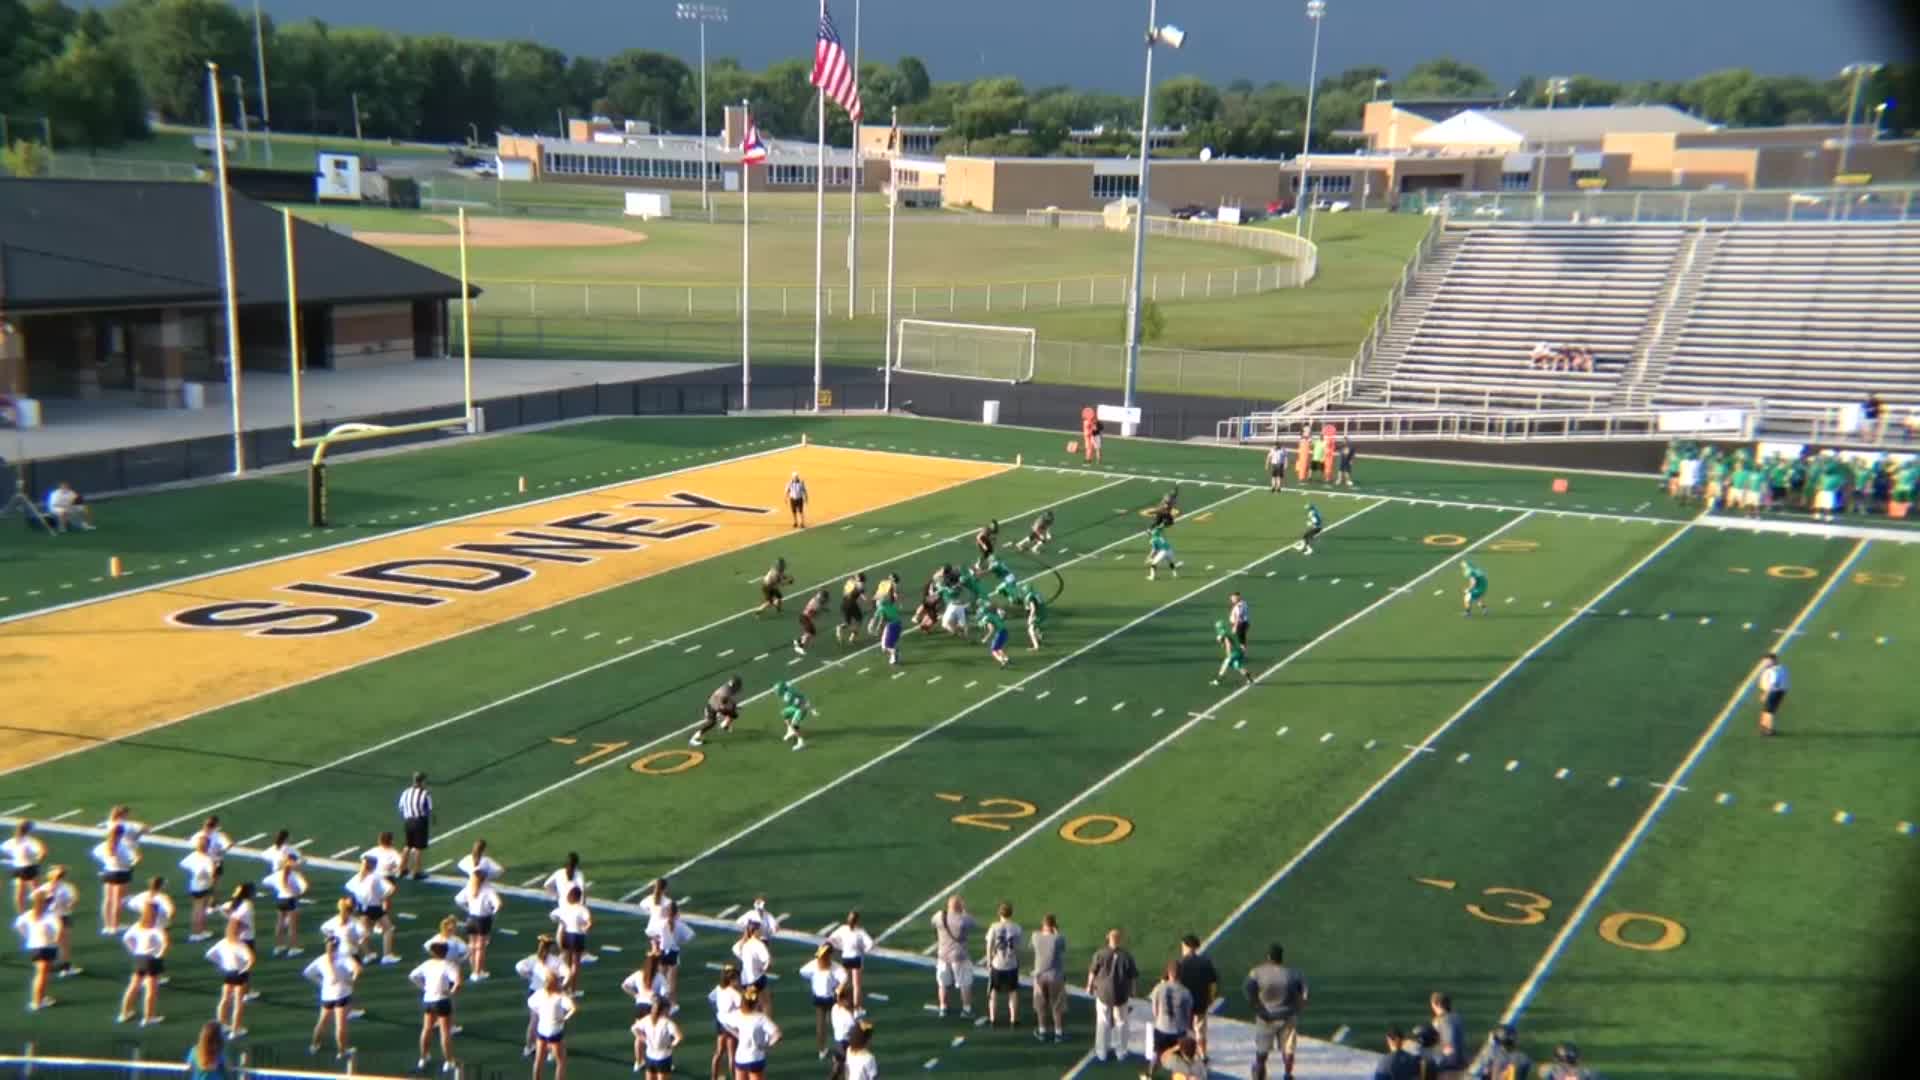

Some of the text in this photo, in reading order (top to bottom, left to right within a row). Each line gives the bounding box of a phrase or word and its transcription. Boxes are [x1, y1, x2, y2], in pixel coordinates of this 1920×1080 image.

[166, 491, 776, 637] SIDNEY
[575, 741, 706, 776] 10
[951, 797, 1135, 846] 20
[1464, 886, 1687, 951] 30
